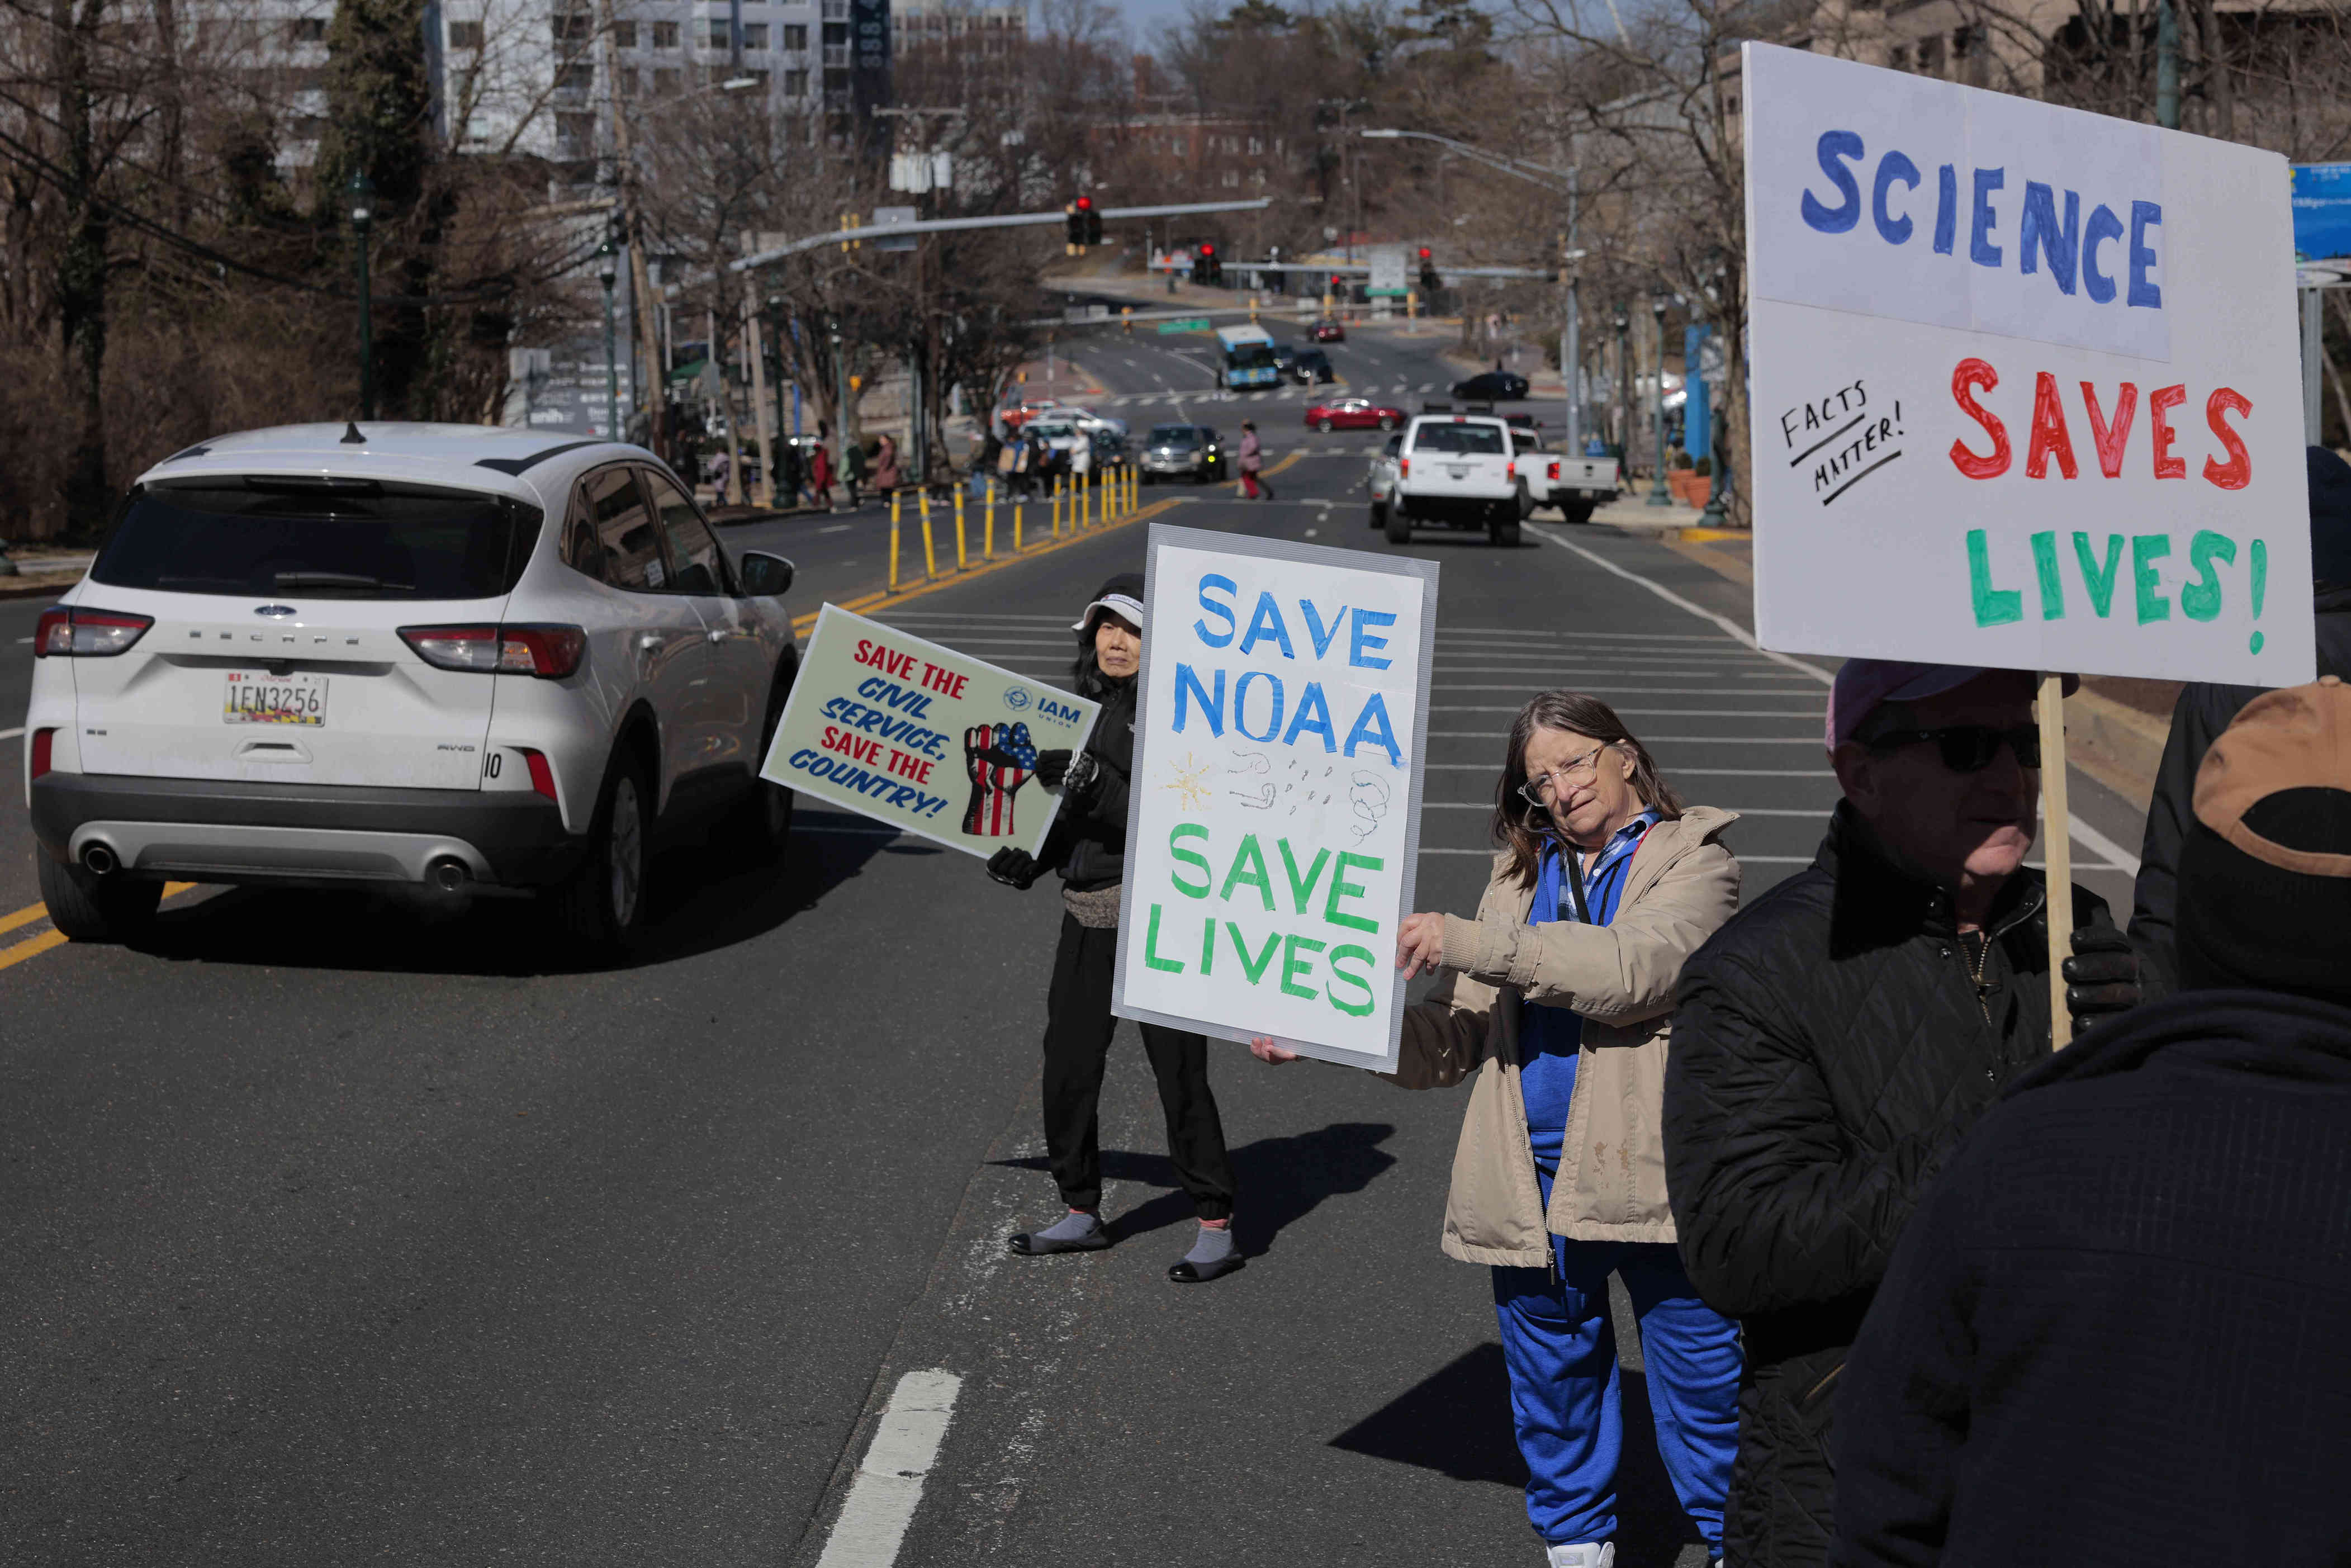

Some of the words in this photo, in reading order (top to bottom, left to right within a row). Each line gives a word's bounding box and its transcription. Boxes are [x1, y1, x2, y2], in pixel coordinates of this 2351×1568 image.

[1800, 129, 2163, 310] SCIENCE
[1781, 380, 1866, 448] FACTS
[1815, 400, 1904, 492] MATTER!
[1949, 357, 2254, 491] SAVES
[1193, 573, 1398, 671] SAVE
[1965, 528, 2268, 656] LIVES!
[231, 685, 319, 713] 1EN3256
[854, 638, 918, 681] SAVE
[921, 662, 970, 700] THE
[856, 676, 933, 721] CIVIL
[819, 697, 951, 761] SERVICE,
[1037, 697, 1082, 724] IAM
[1039, 713, 1072, 729] UNION
[1171, 662, 1403, 769] NOAA
[788, 749, 949, 819] COUNTRY!
[820, 725, 884, 767] SAVE
[887, 748, 936, 786] THE
[1169, 822, 1385, 935] SAVE
[1144, 902, 1376, 1019] LIVES
